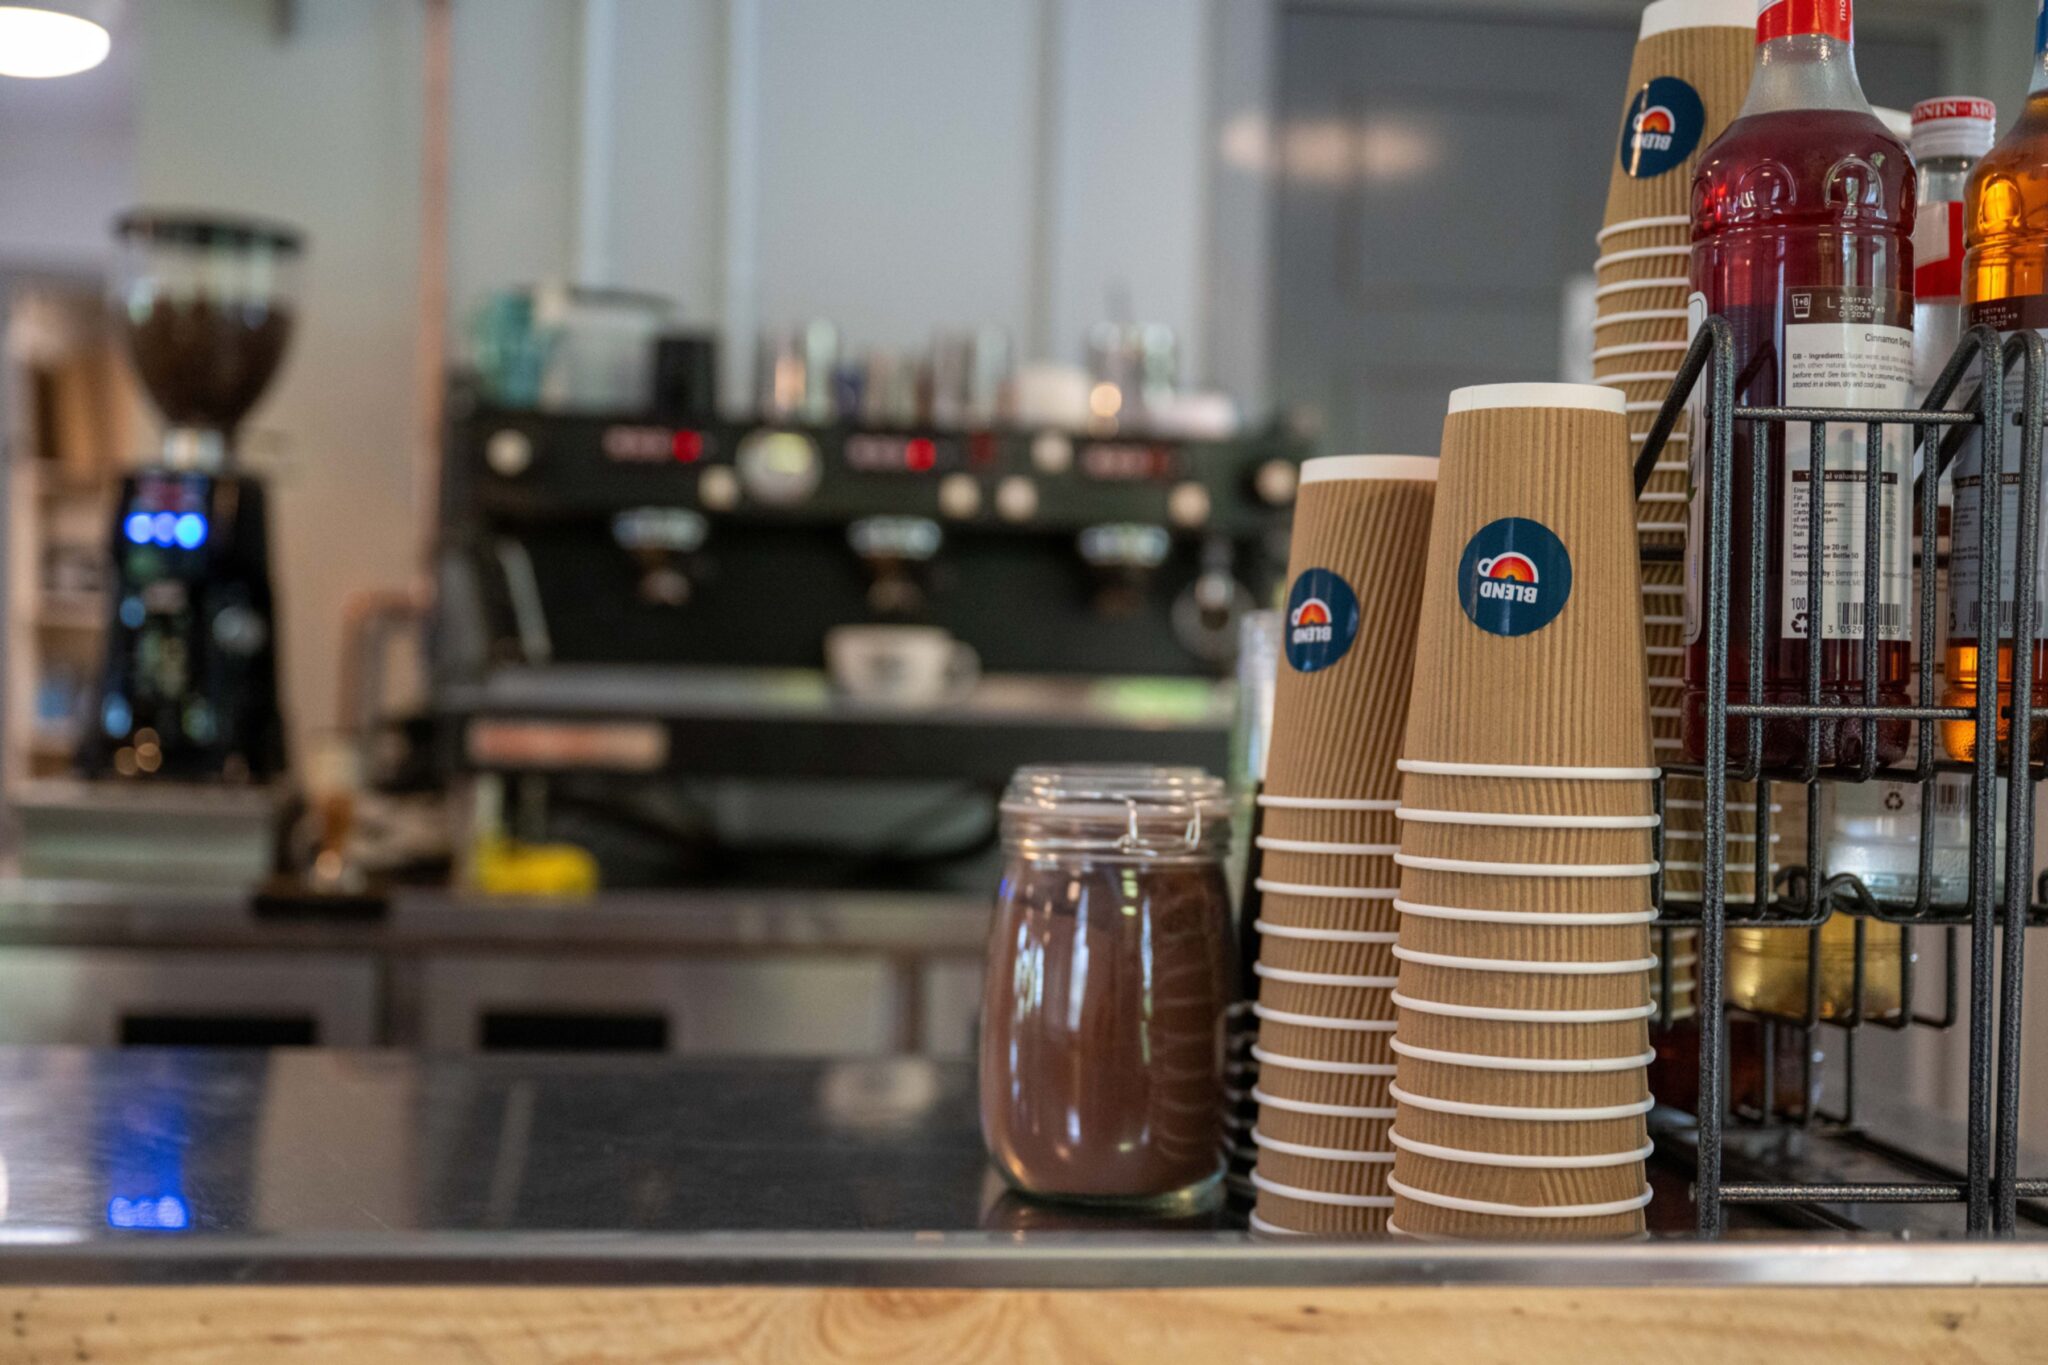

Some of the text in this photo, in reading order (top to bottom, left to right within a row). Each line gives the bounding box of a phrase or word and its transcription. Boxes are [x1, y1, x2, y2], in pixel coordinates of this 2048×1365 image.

[1827, 296, 1836, 308] L
[1864, 333, 1898, 344] Cinnamon
[1480, 581, 1538, 603] BLEND
[1791, 597, 1806, 610] 100
[1292, 625, 1332, 644] BLEND
[1828, 625, 1834, 633] 3
